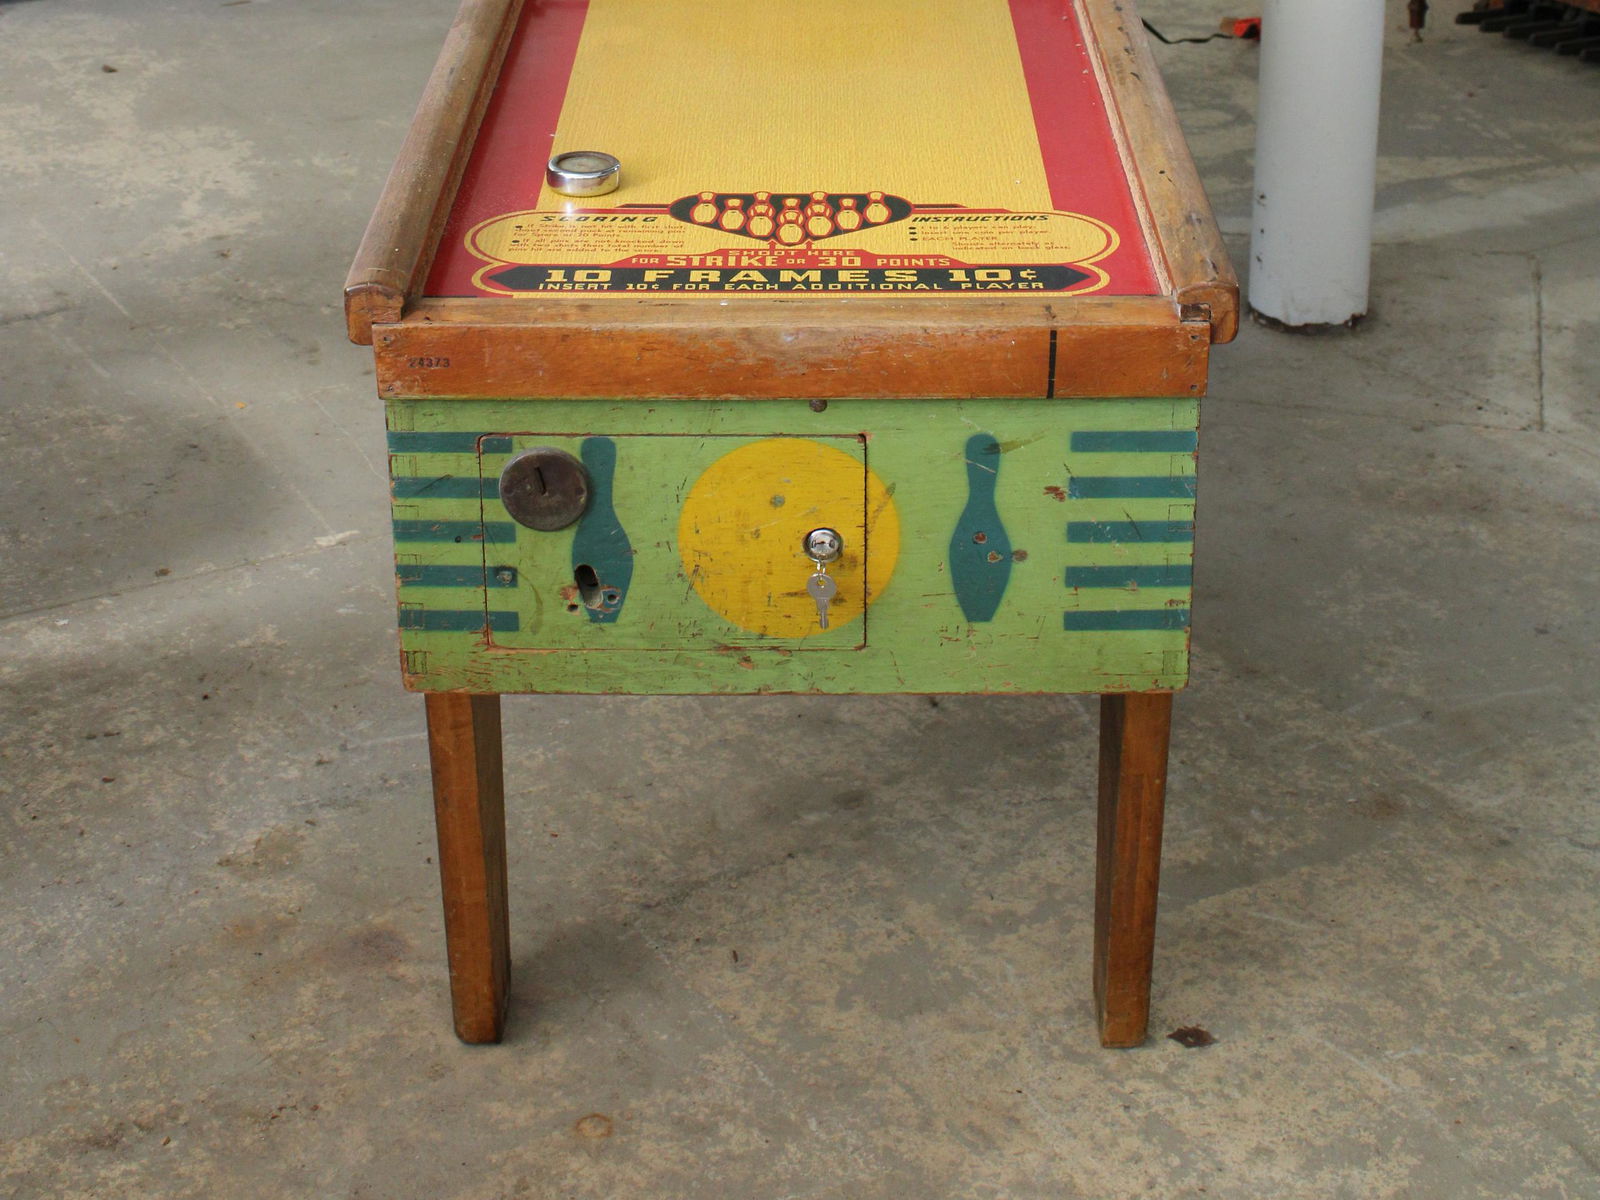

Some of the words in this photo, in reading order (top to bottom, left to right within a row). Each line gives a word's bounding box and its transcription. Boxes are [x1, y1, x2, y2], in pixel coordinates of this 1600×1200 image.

[912, 215, 1049, 223] INSTRUCTIONS
[666, 256, 777, 266] STRIKE
[818, 257, 861, 267] 30
[876, 258, 950, 266] POINTS
[545, 269, 612, 282] 10
[644, 269, 918, 282] FRAMES
[949, 269, 1037, 282] 10¢
[961, 282, 1044, 290] PLAYER
